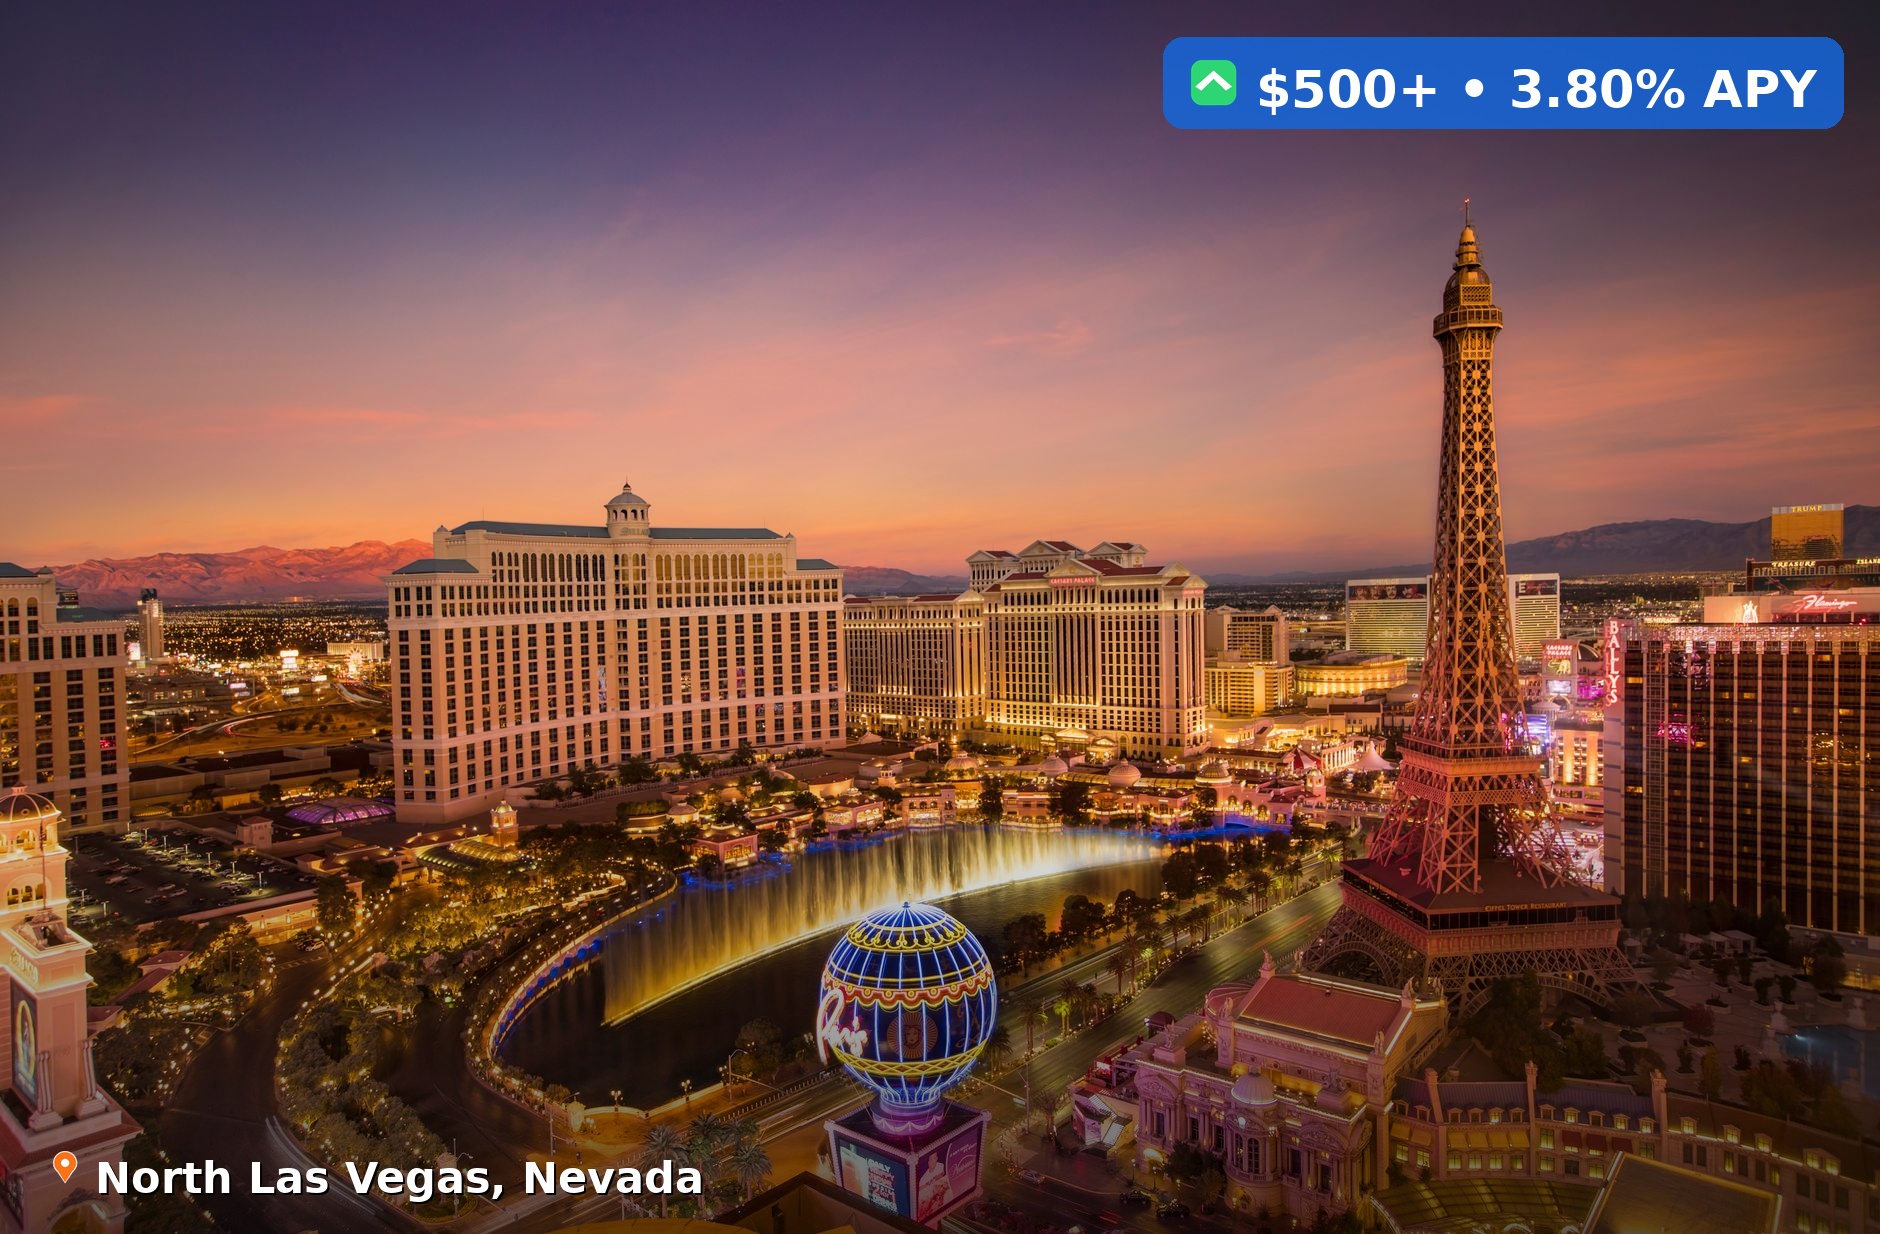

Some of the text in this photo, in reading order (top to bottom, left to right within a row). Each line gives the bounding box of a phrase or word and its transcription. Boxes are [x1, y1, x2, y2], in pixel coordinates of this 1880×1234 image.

[1791, 505, 1823, 513] TRUMP
[1771, 560, 1816, 568] TREASURE
[1802, 594, 1857, 610] Flamingo
